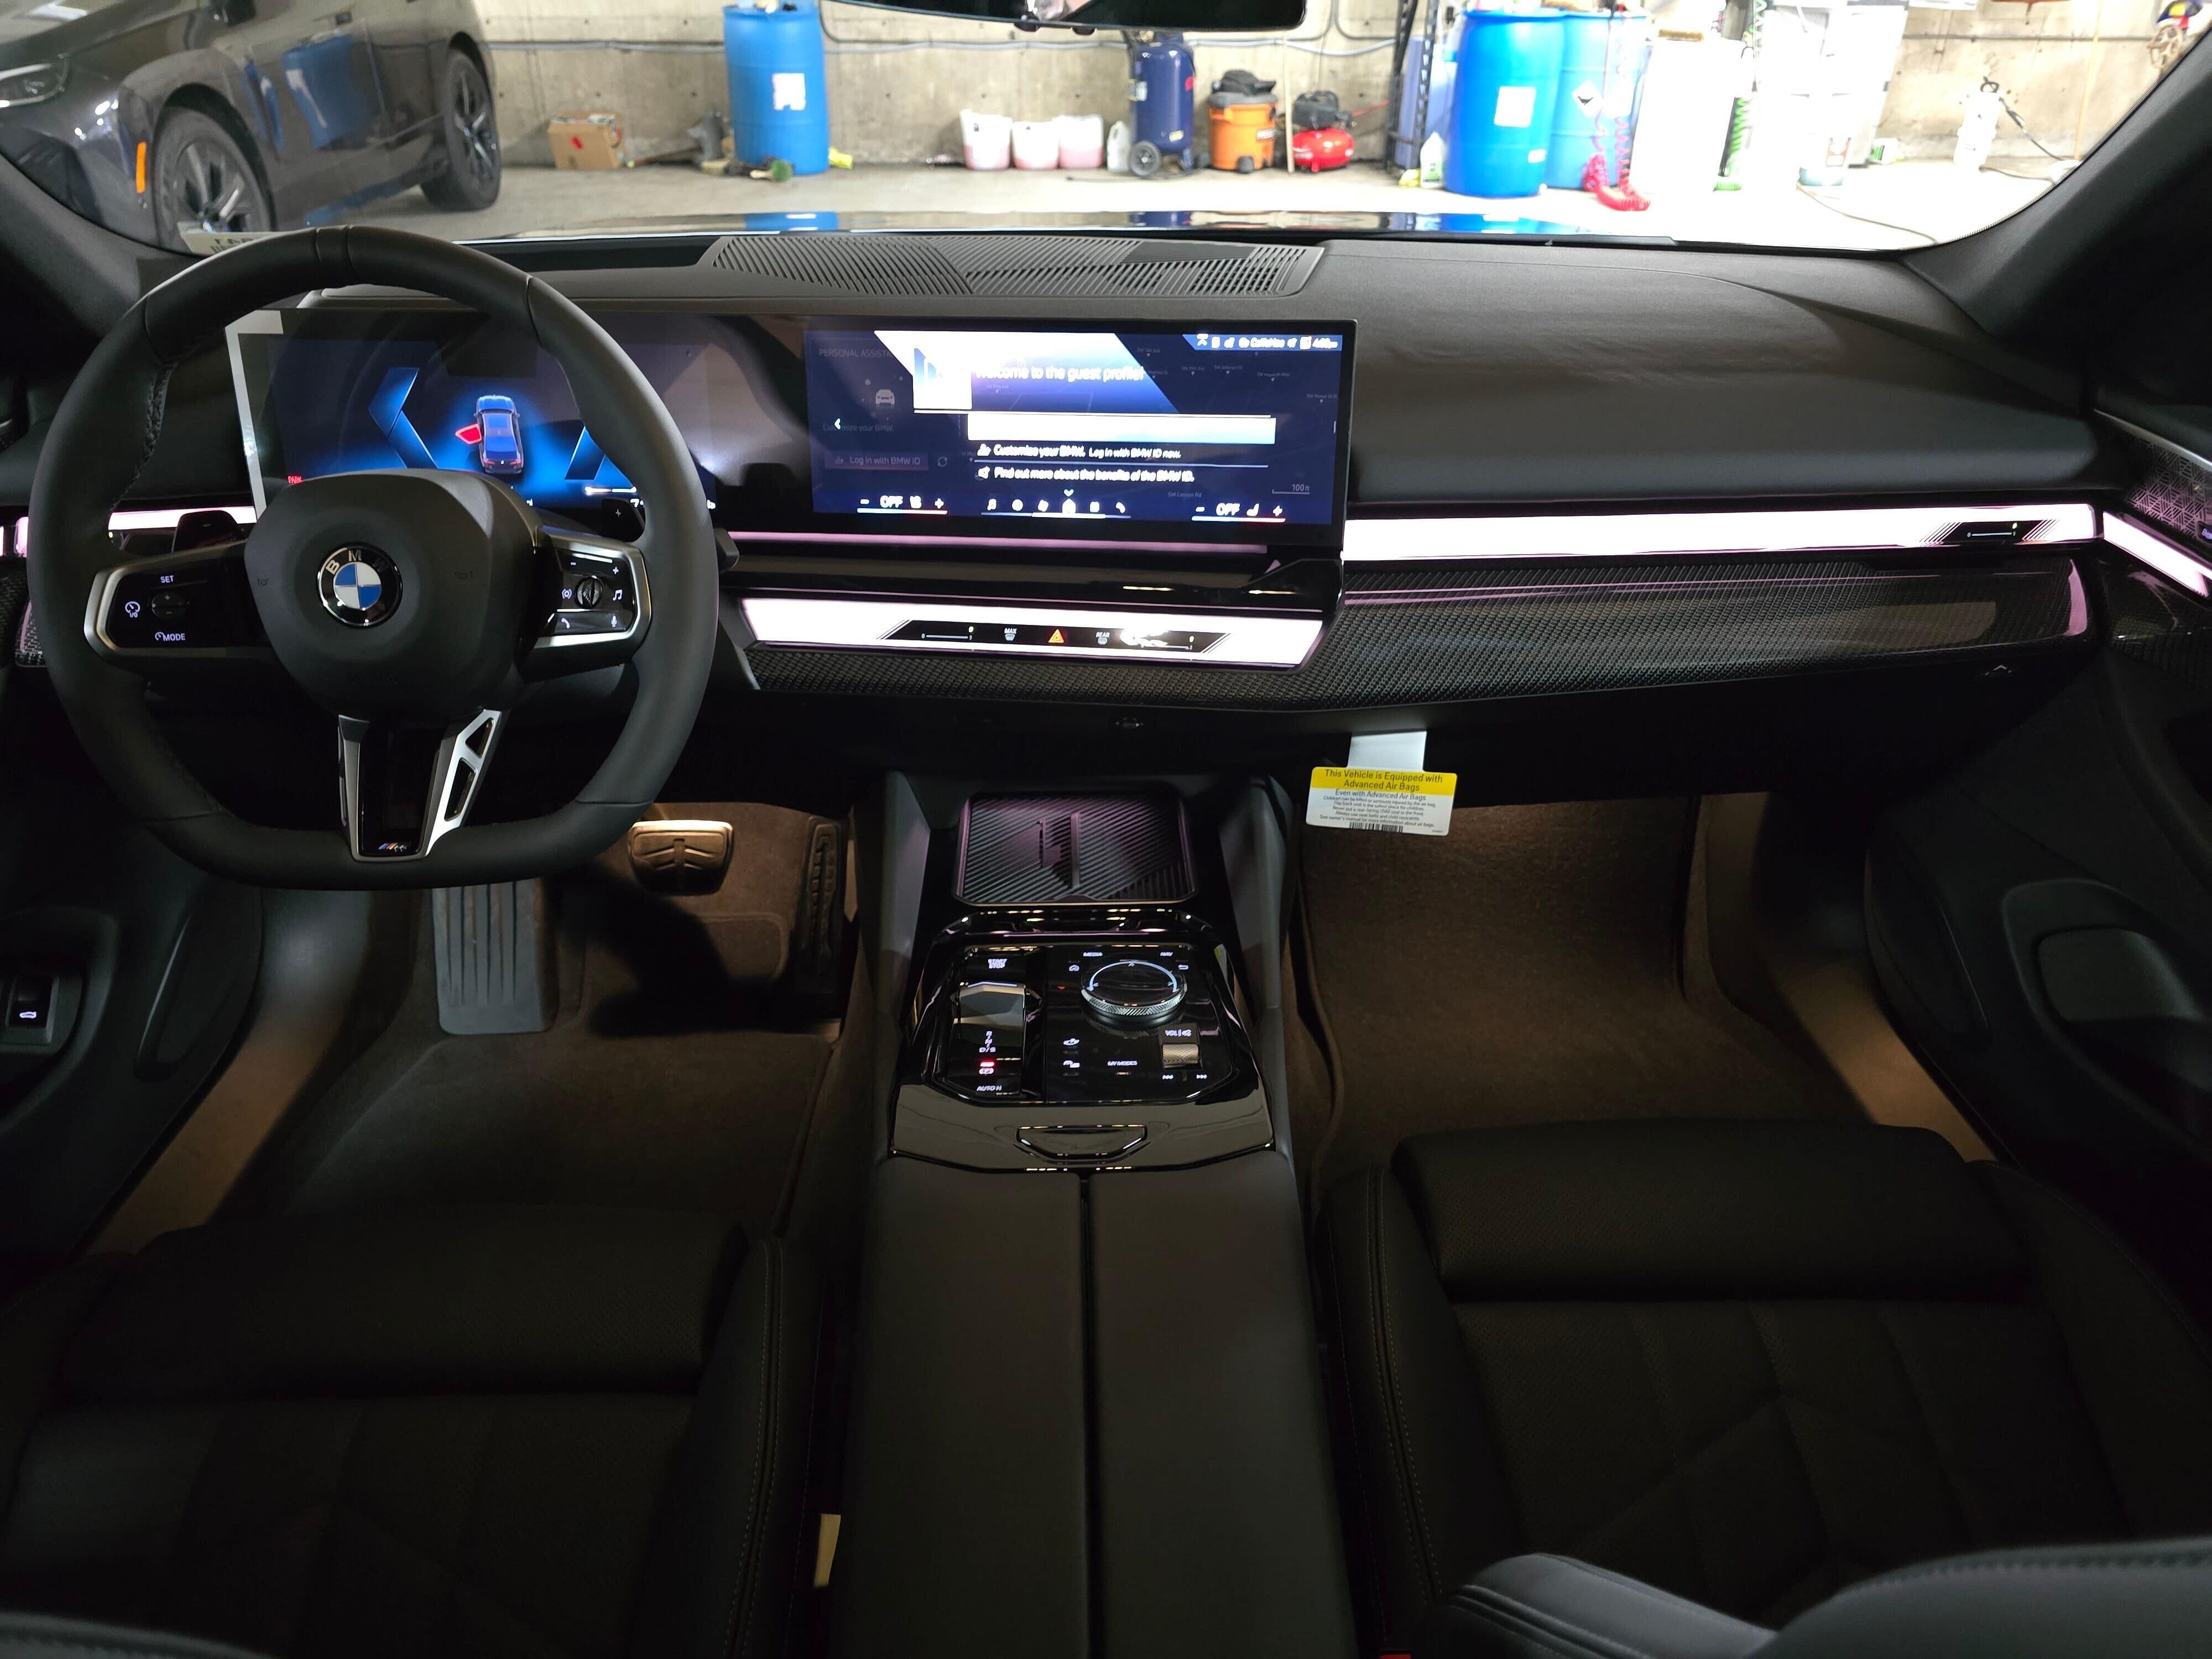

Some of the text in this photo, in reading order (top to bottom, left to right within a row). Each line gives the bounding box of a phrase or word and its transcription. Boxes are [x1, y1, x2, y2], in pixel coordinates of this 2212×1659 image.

[819, 349, 893, 358] PERSONAL ASSISTA
[1031, 366, 1044, 379] to
[1045, 365, 1066, 380] the
[1089, 447, 1104, 458] Log
[1105, 447, 1113, 457] in
[1113, 447, 1130, 458] with
[849, 456, 864, 465] Log
[880, 495, 904, 508] OFF
[1216, 503, 1240, 515] OFF
[325, 549, 388, 575] BMW
[160, 575, 174, 583] SET
[163, 633, 186, 641] MODE
[1324, 769, 1342, 778] This
[1344, 770, 1373, 779] Vehicle
[1384, 772, 1424, 782] Equipped
[1425, 774, 1443, 783] with
[1343, 779, 1420, 792] Advanced Air Bags
